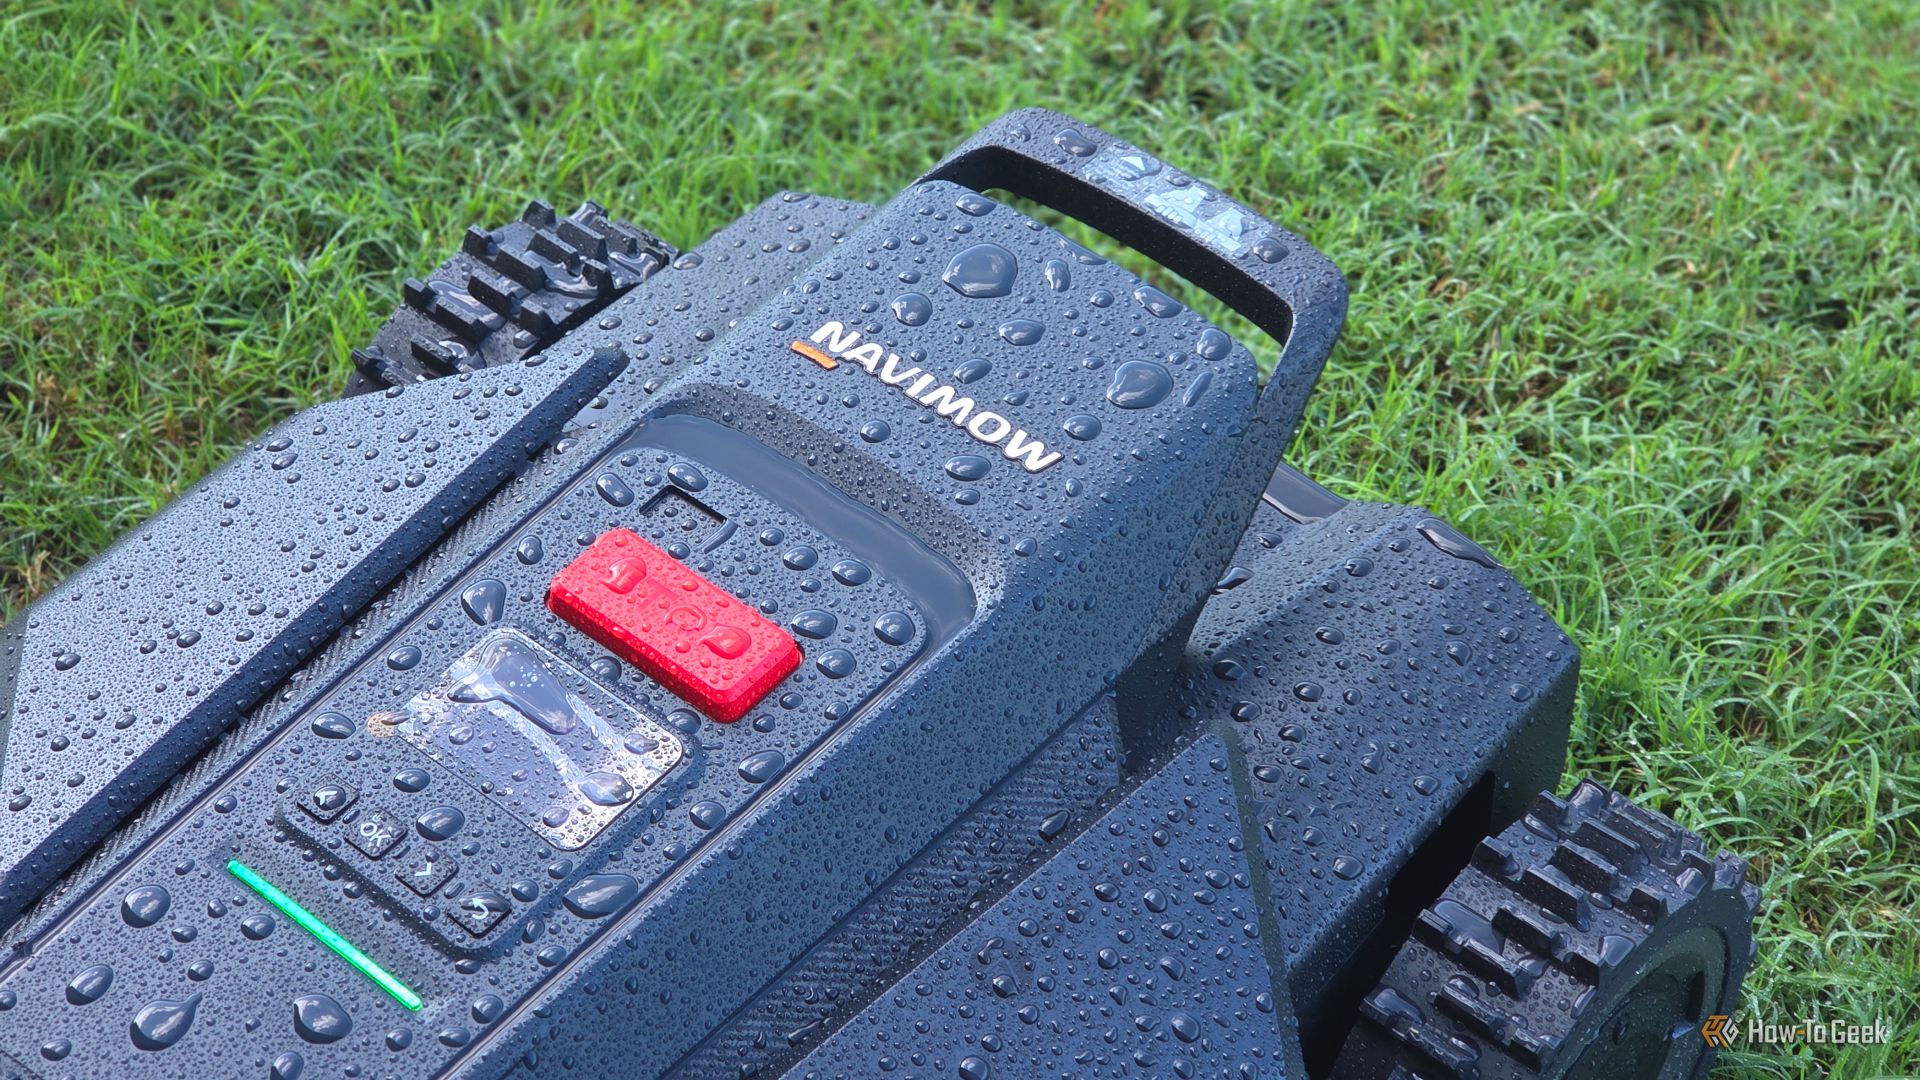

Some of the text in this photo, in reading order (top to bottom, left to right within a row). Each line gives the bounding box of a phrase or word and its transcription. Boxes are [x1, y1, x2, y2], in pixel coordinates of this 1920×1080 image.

[809, 320, 1064, 473] NAVIMOW
[600, 557, 752, 660] TO
[360, 822, 392, 848] OK
